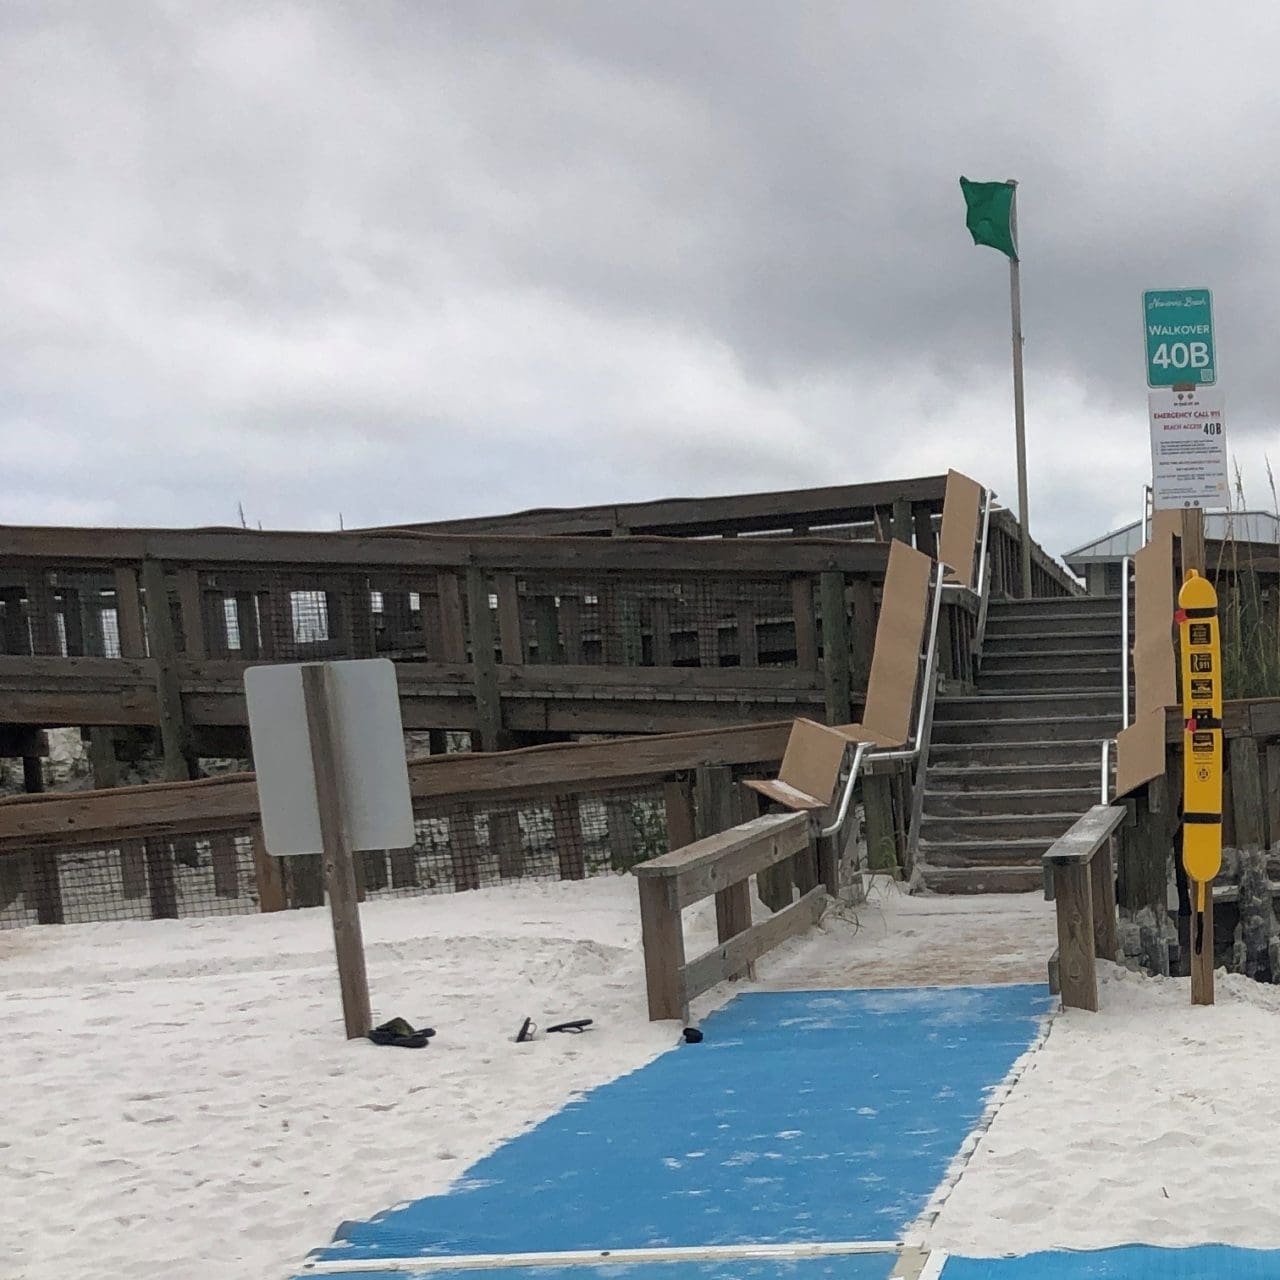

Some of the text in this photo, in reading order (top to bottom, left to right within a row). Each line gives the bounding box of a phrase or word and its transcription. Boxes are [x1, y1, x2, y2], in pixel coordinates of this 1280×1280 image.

[1148, 324, 1210, 336] WALKOVER
[1152, 342, 1210, 369] 40B
[1153, 411, 1192, 419] EMERGENCY
[1203, 422, 1222, 435] 40B
[1200, 661, 1210, 669] 911
